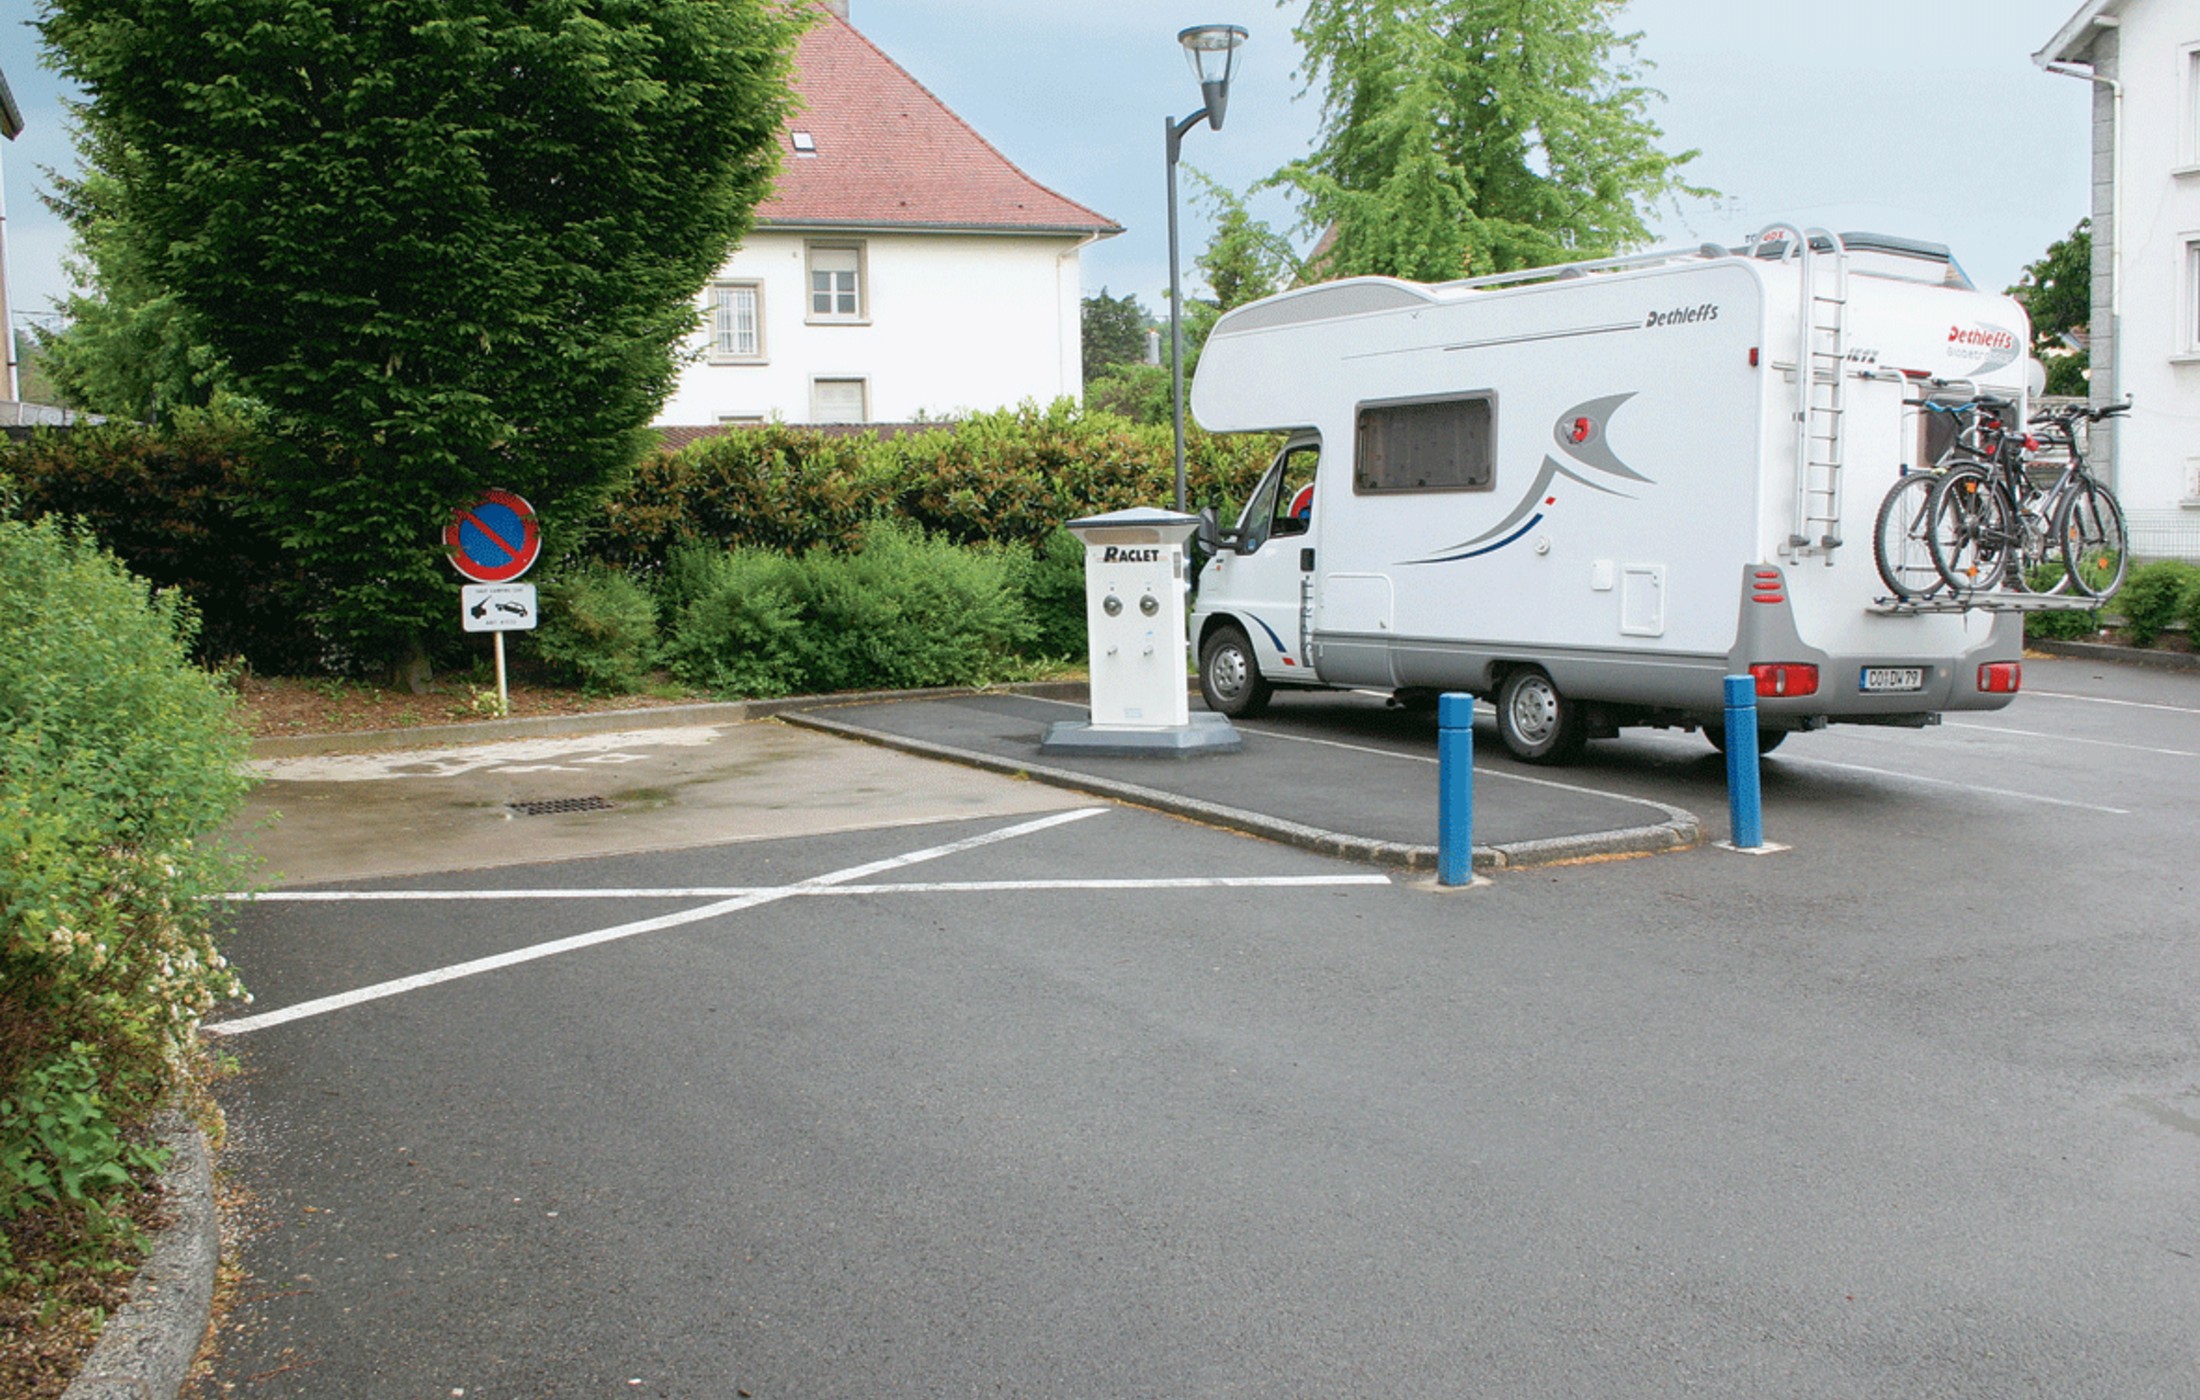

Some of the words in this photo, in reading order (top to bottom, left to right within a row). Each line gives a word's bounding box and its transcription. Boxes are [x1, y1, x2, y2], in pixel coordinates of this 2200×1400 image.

[1646, 303, 1719, 328] Dethleffs
[1947, 325, 2012, 349] Dethleffs
[1103, 545, 1160, 563] RACLET
